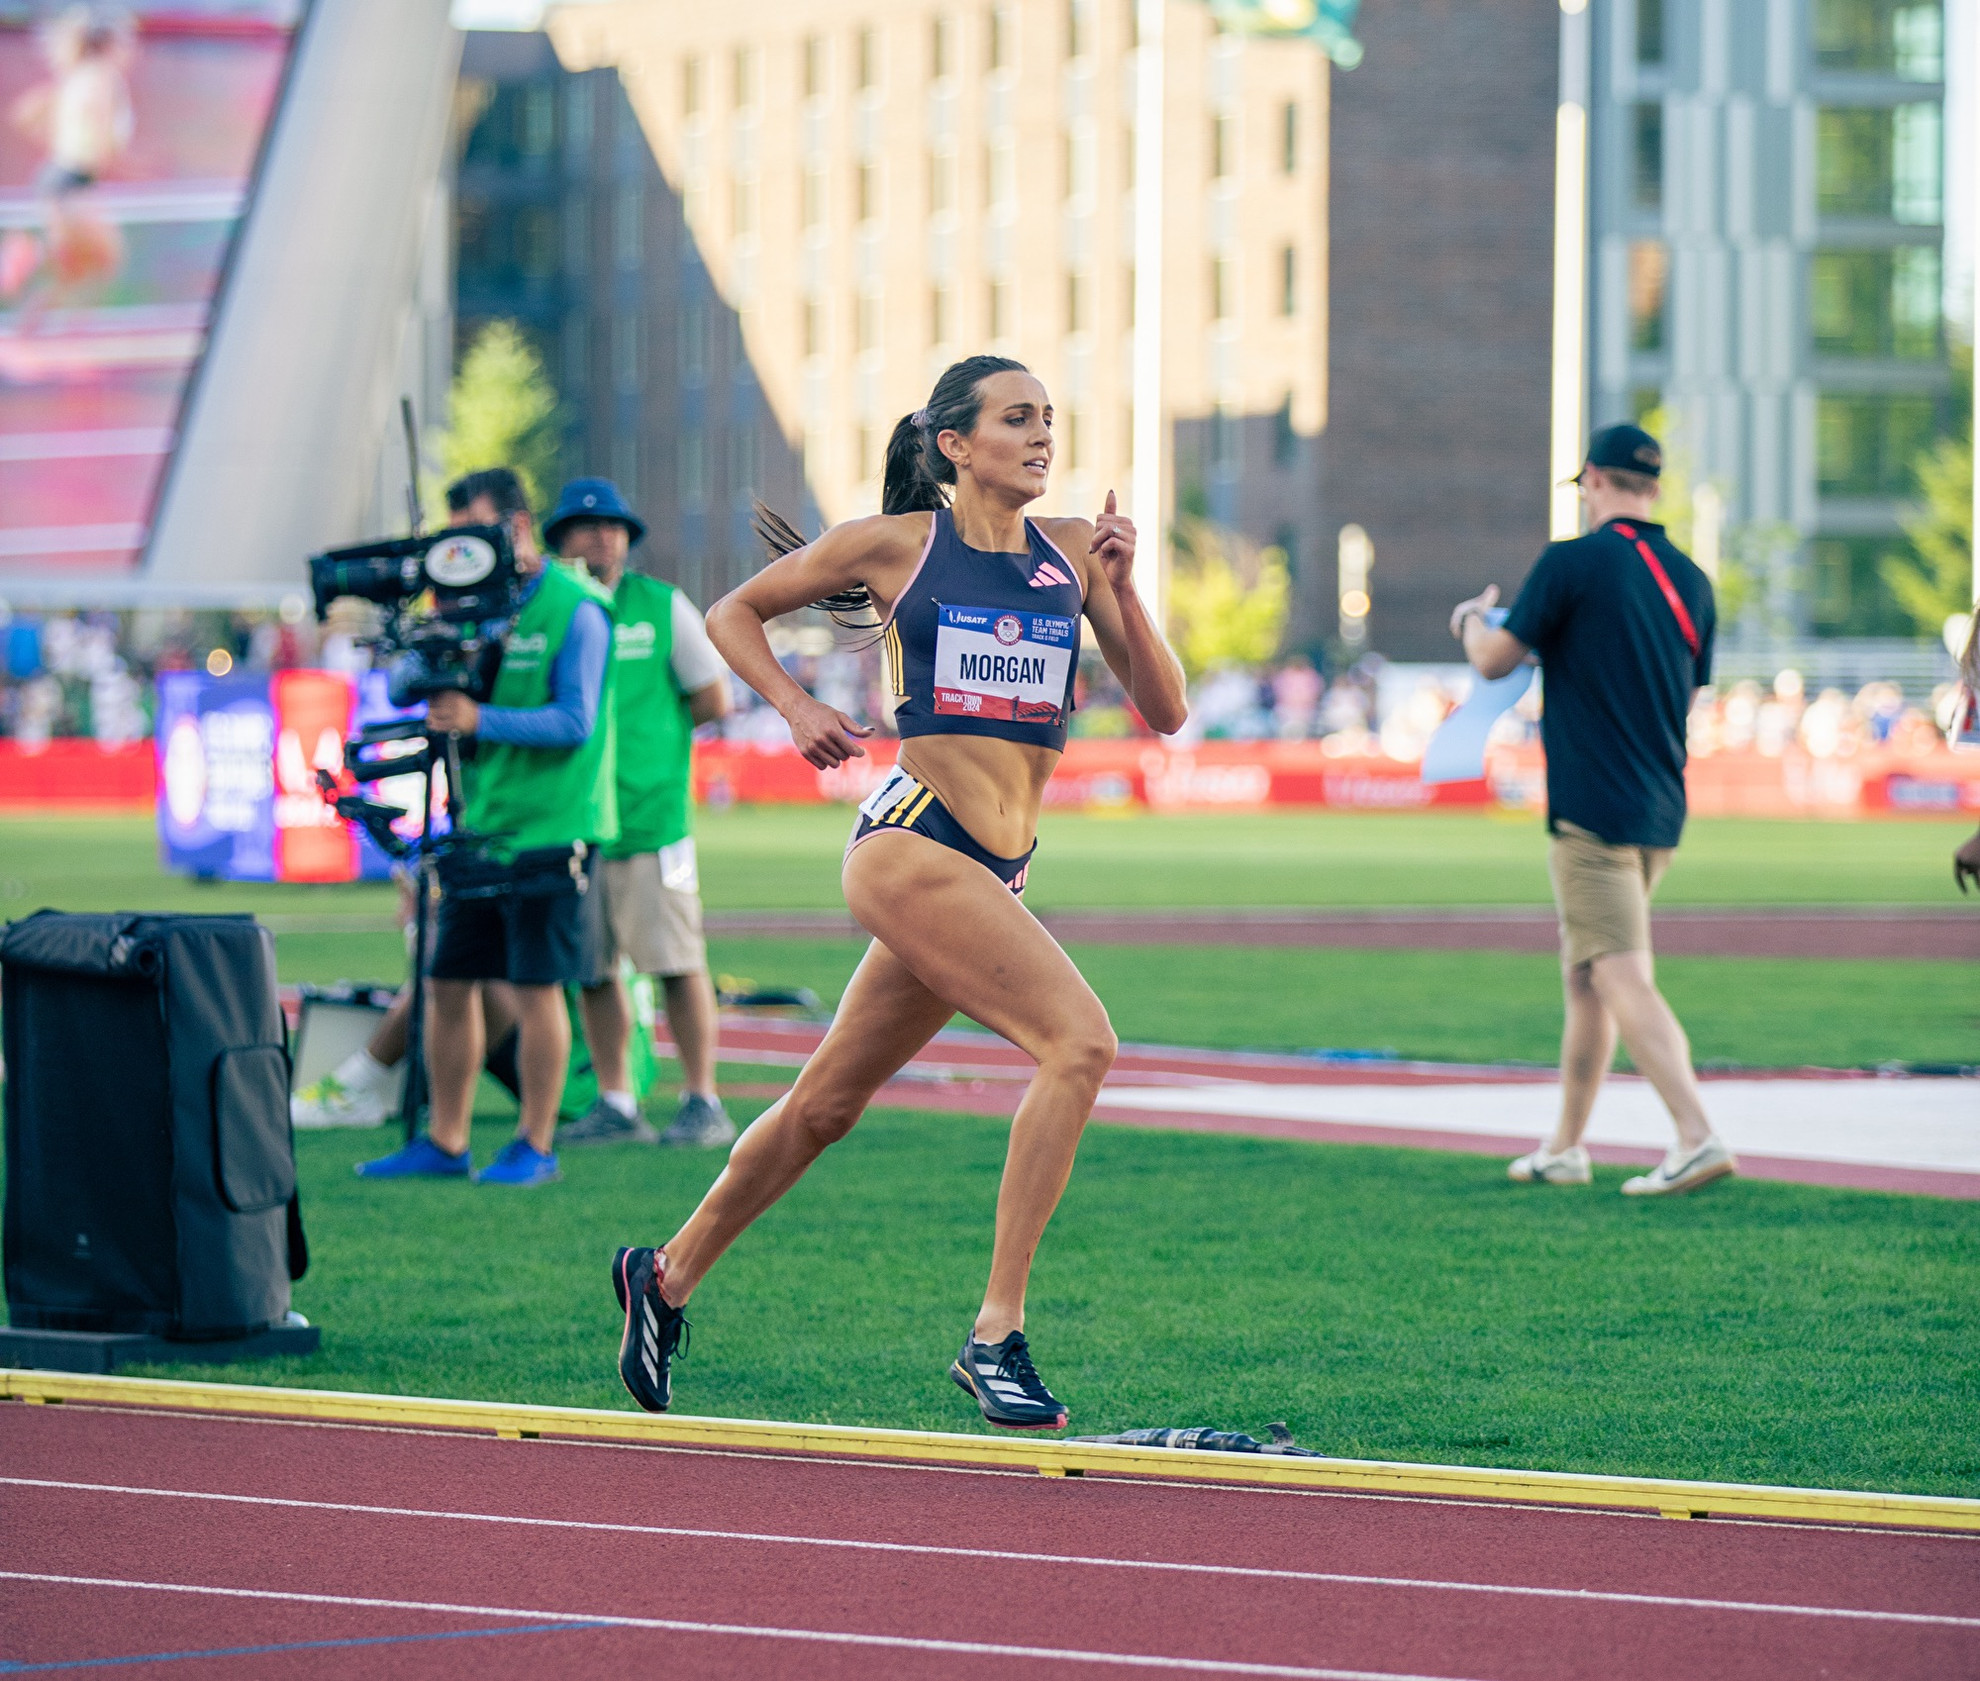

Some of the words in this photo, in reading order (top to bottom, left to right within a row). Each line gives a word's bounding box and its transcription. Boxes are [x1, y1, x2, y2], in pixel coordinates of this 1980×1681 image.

[960, 615, 988, 624] USATF
[1032, 618, 1044, 626] U.S.
[1045, 619, 1070, 629] OLYMPIC
[1031, 626, 1048, 634] TEAM
[1049, 628, 1069, 637] TRIALS
[960, 653, 1046, 685] MORGAN
[962, 702, 980, 712] 2024
